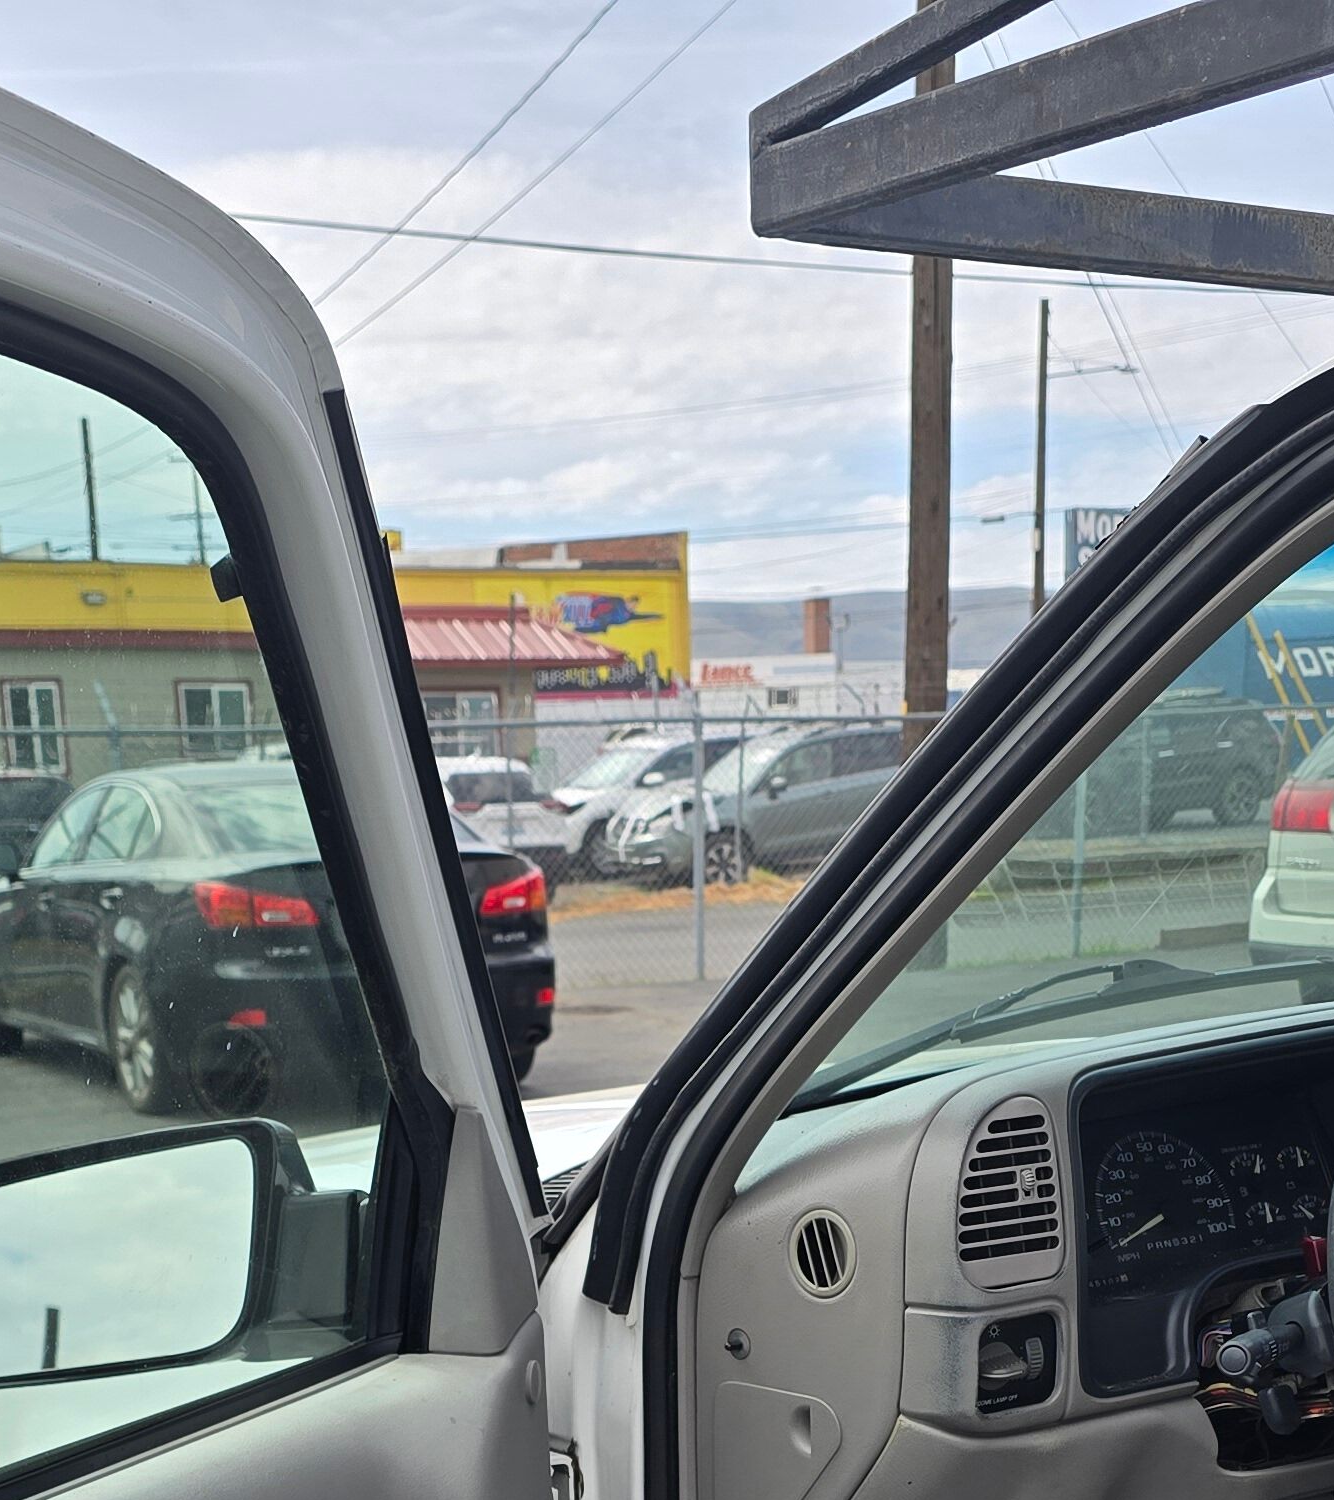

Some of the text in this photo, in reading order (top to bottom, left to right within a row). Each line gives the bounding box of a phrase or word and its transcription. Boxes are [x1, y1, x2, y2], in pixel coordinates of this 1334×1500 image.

[1136, 1141, 1153, 1152] 50
[1158, 1143, 1175, 1154] 60
[1117, 1152, 1134, 1163] 40
[1180, 1157, 1196, 1169] 70
[1108, 1169, 1126, 1181] 30
[1194, 1174, 1212, 1186] 80
[1105, 1192, 1122, 1205] 20
[1206, 1197, 1224, 1209] 90
[1107, 1216, 1122, 1227] 10
[1207, 1222, 1228, 1234] 100
[1116, 1251, 1141, 1264] MPH
